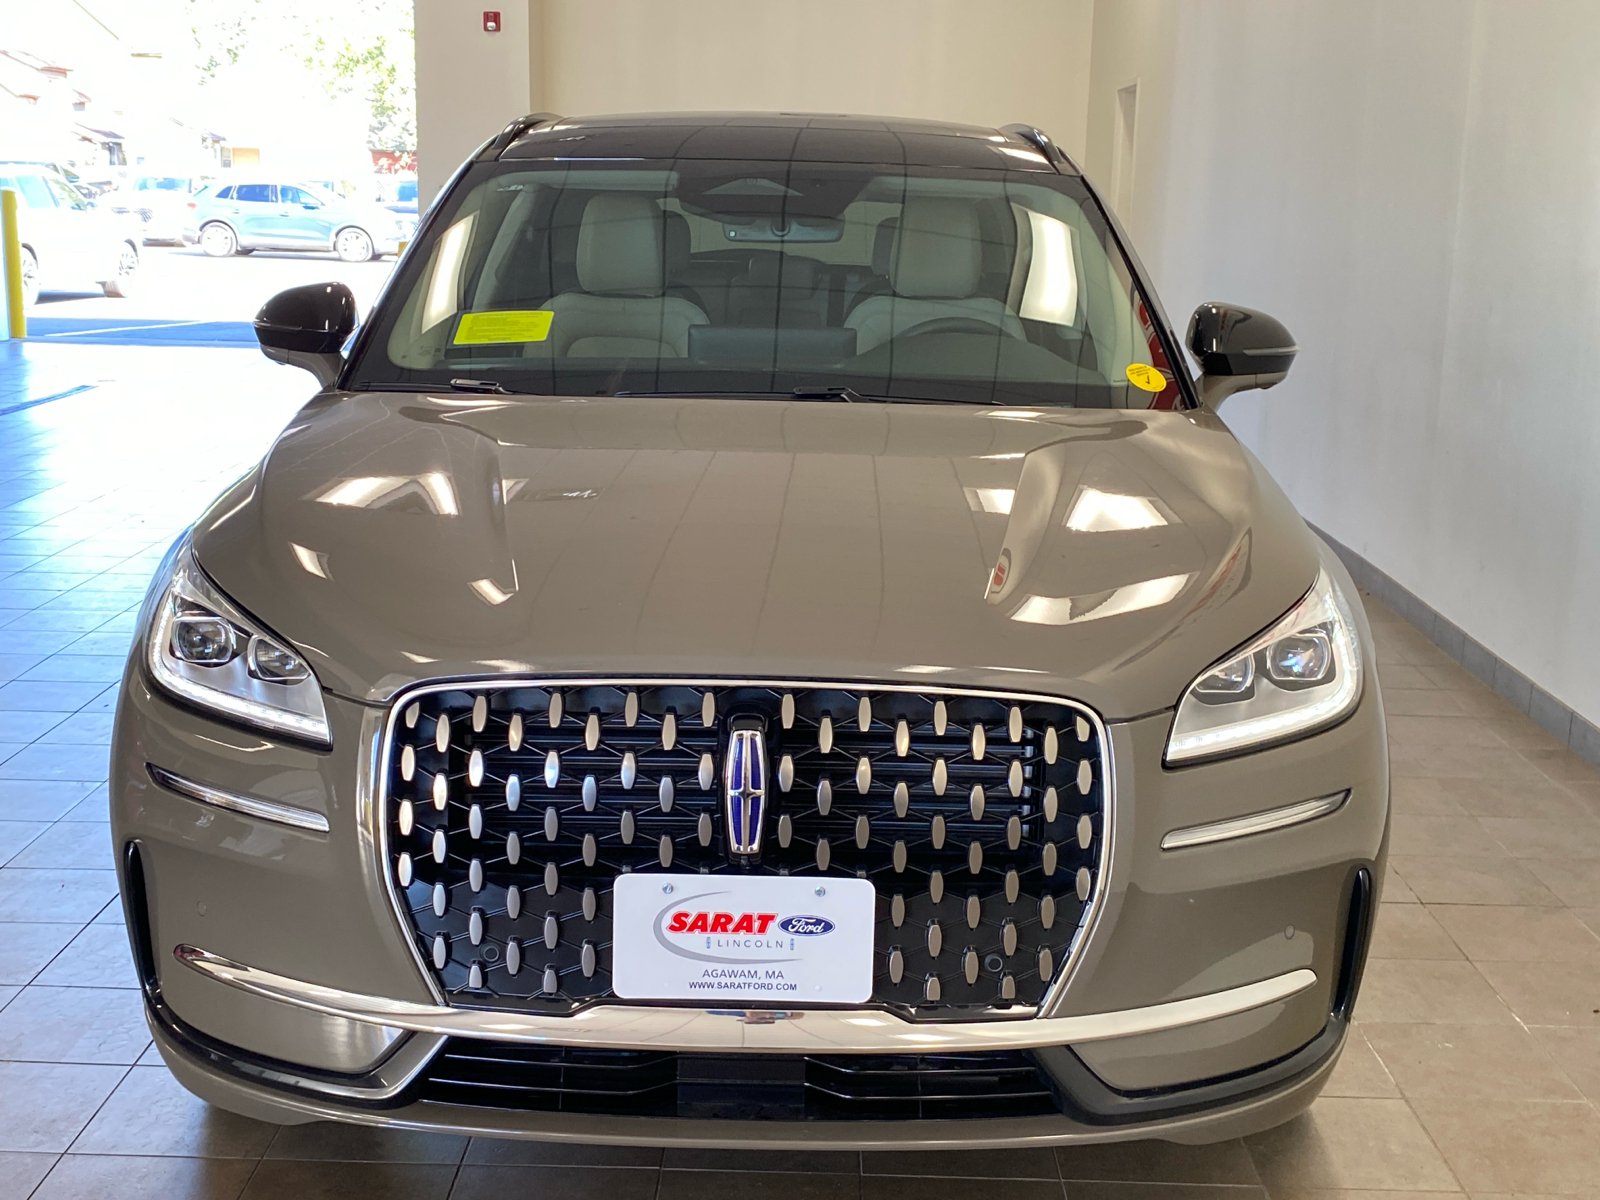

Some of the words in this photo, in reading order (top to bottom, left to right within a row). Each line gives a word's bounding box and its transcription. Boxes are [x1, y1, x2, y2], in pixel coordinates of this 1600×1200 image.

[666, 911, 778, 935] SARAT
[788, 917, 824, 933] Ford
[717, 939, 784, 949] LINCOLN
[702, 969, 761, 980] AGAWAM,
[765, 970, 785, 980] MA
[688, 982, 797, 991] WWW.SARATFORD.COM
